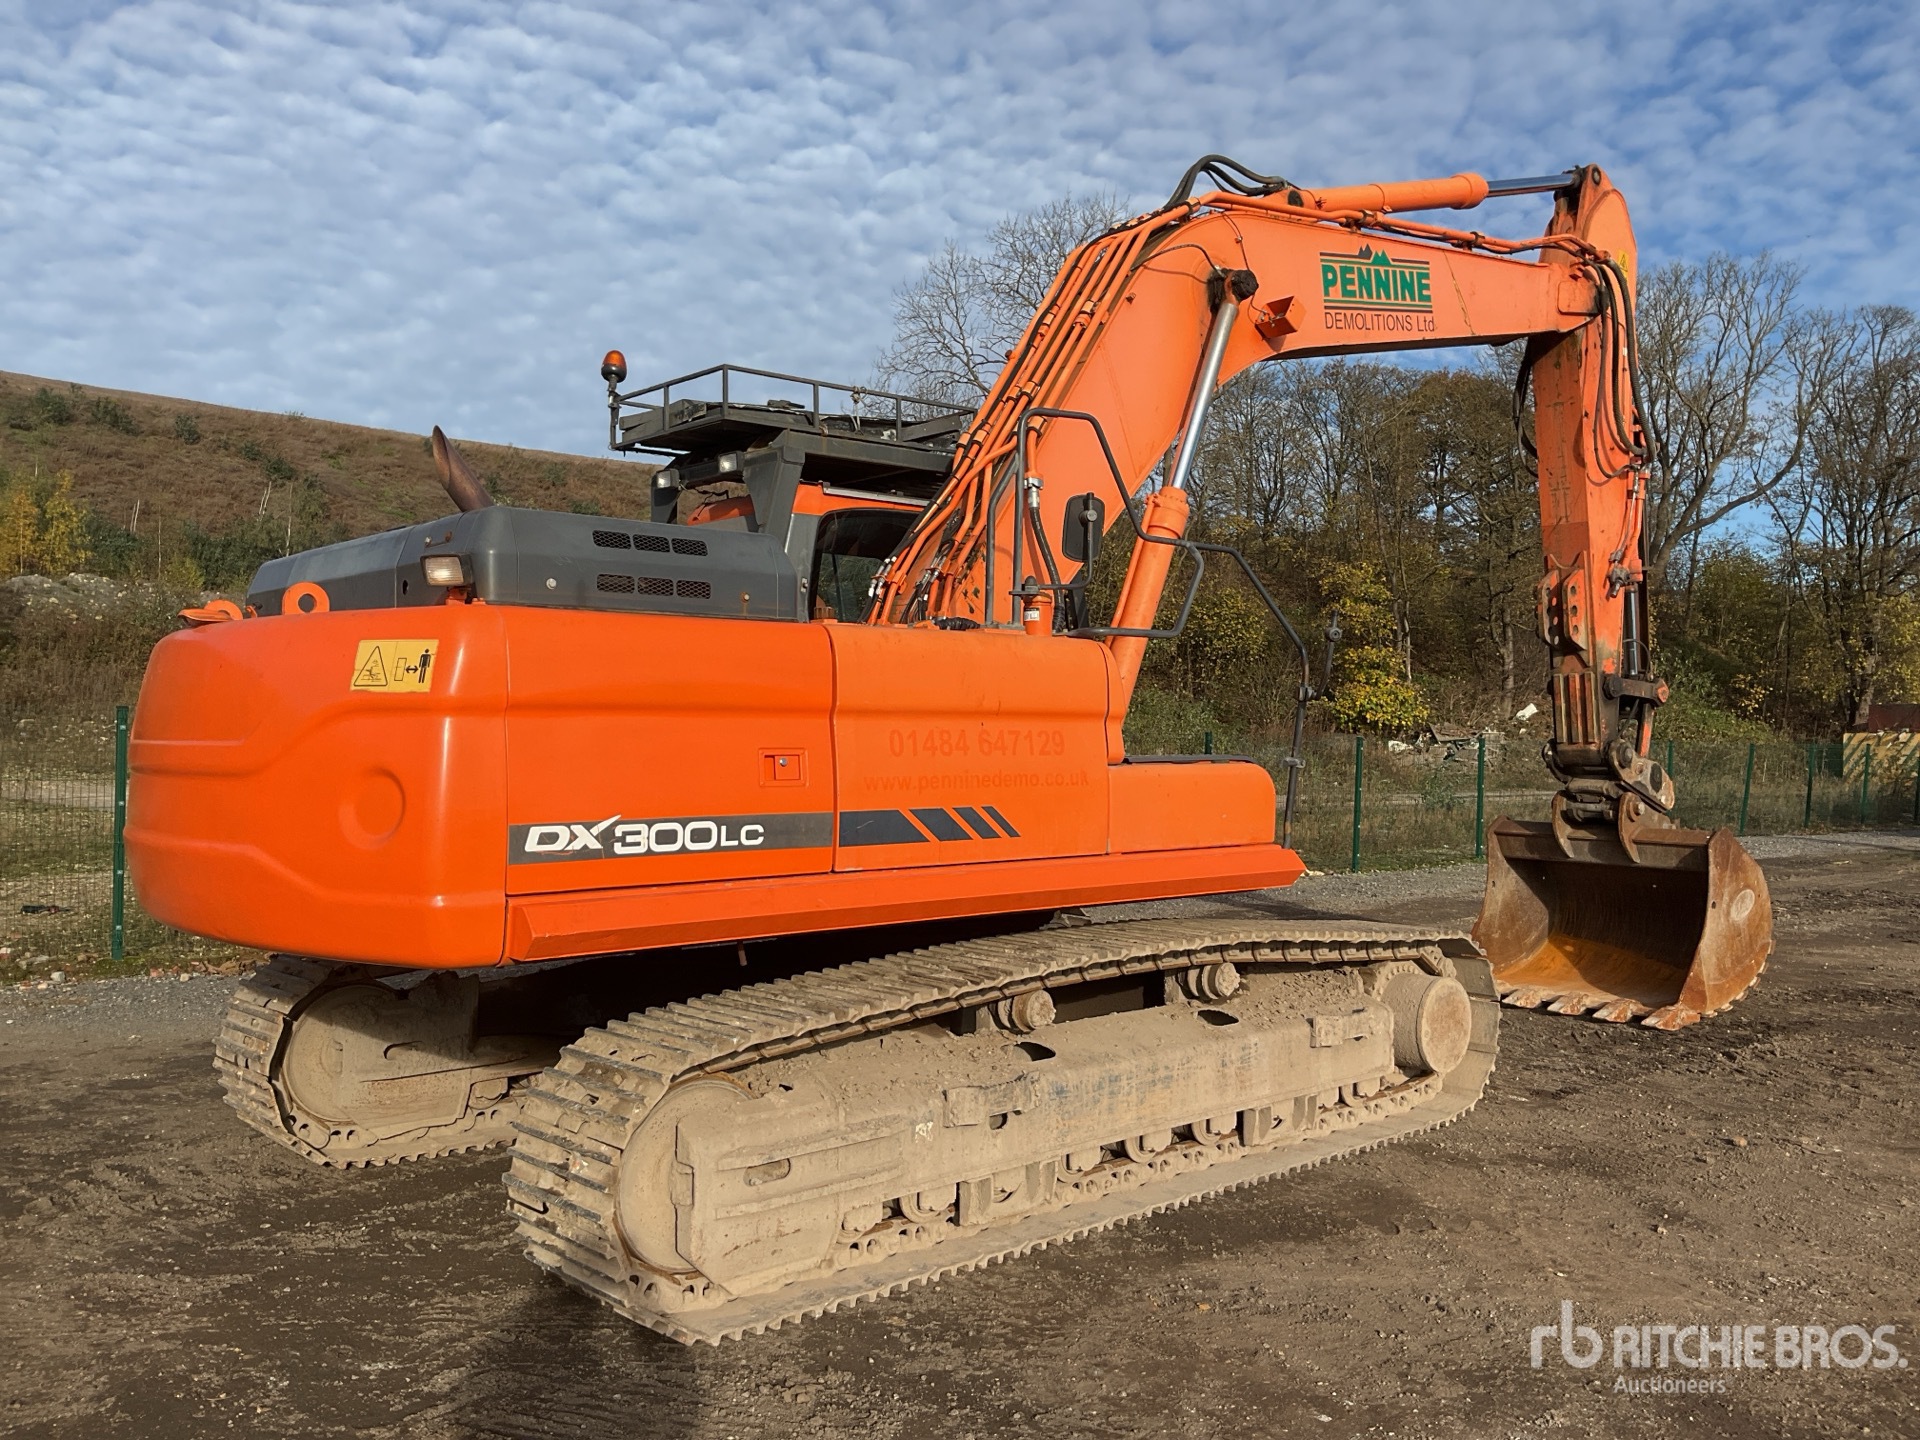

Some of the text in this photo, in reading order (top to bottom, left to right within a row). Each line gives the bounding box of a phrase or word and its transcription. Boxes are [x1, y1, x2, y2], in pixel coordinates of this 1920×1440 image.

[1321, 264, 1432, 303] PENNINE
[1324, 312, 1435, 332] DEMOLITIONS Ltd
[889, 729, 1065, 757] 01484 647129
[864, 769, 1089, 794] www.penninedemo.co.uk
